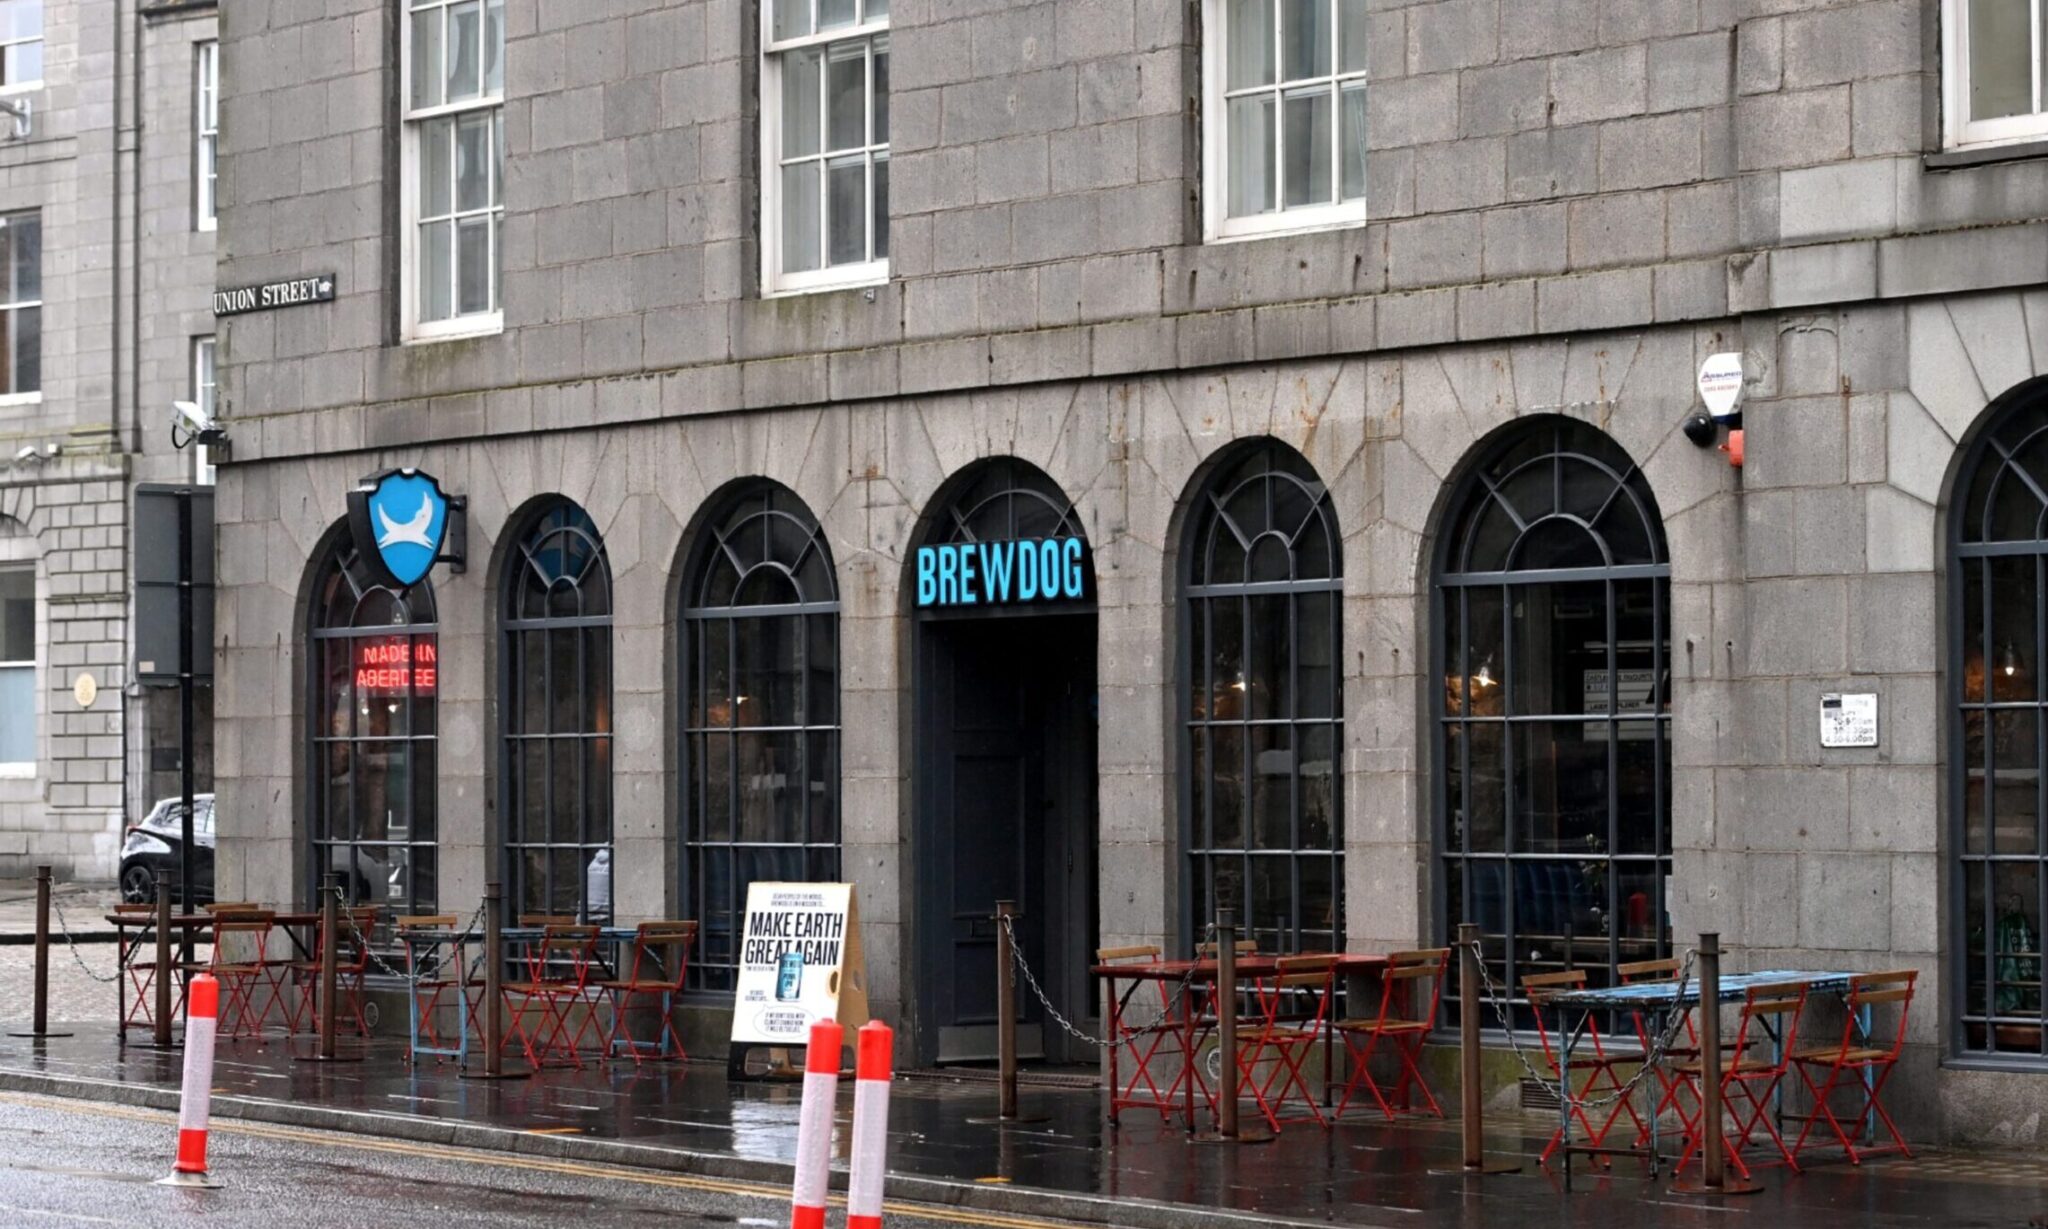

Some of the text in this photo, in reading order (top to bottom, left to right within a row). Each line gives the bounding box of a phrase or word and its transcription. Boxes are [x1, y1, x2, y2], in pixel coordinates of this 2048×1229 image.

[214, 278, 319, 313] UNION STREET
[918, 537, 1083, 606] BREWDOG
[364, 644, 436, 664] MADE IN
[356, 668, 436, 688] ABERDEE
[749, 911, 843, 938] MAKE EARTH
[745, 939, 840, 966] GREAT AGAIN
